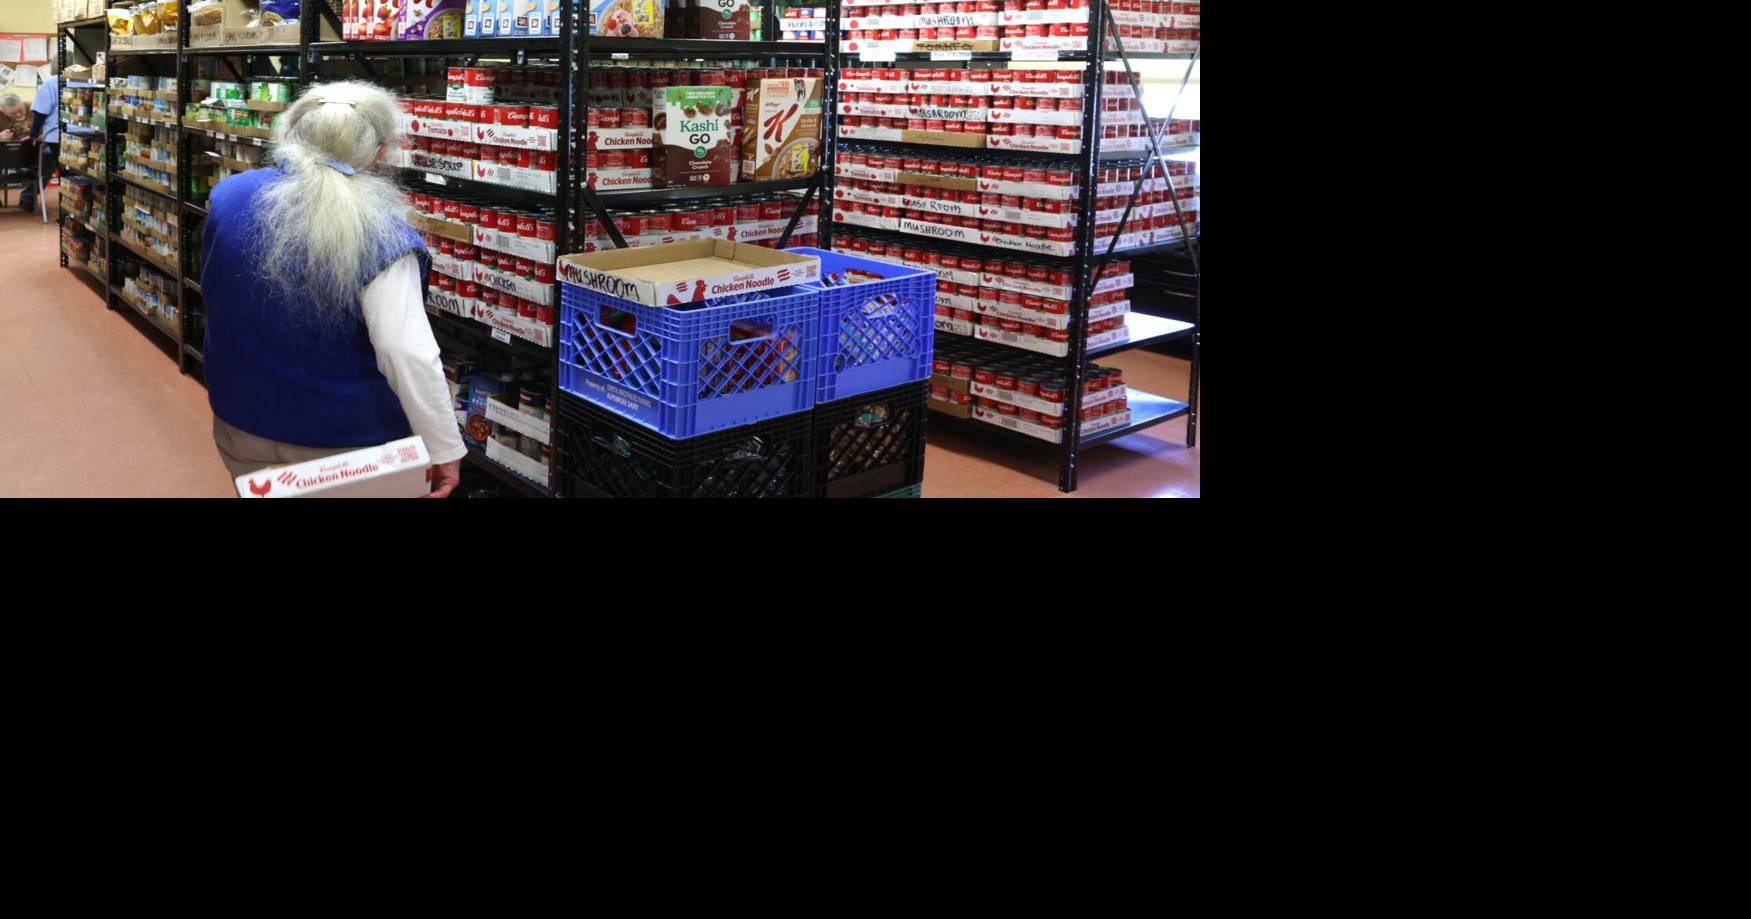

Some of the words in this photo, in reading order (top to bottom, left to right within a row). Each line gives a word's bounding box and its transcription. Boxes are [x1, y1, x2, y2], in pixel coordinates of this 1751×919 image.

[680, 119, 719, 133] Kashi
[763, 103, 799, 143] K
[604, 137, 635, 146] Chicken
[689, 133, 711, 145] GO
[602, 177, 632, 186] Chicken
[741, 229, 767, 238] Chicken
[903, 221, 965, 239] MUSHROOM
[565, 263, 640, 302] MUSHROOM
[712, 282, 745, 294] Chicken
[746, 277, 775, 289] Noodle
[296, 472, 339, 489] Chicken
[339, 463, 379, 479] Noodle
